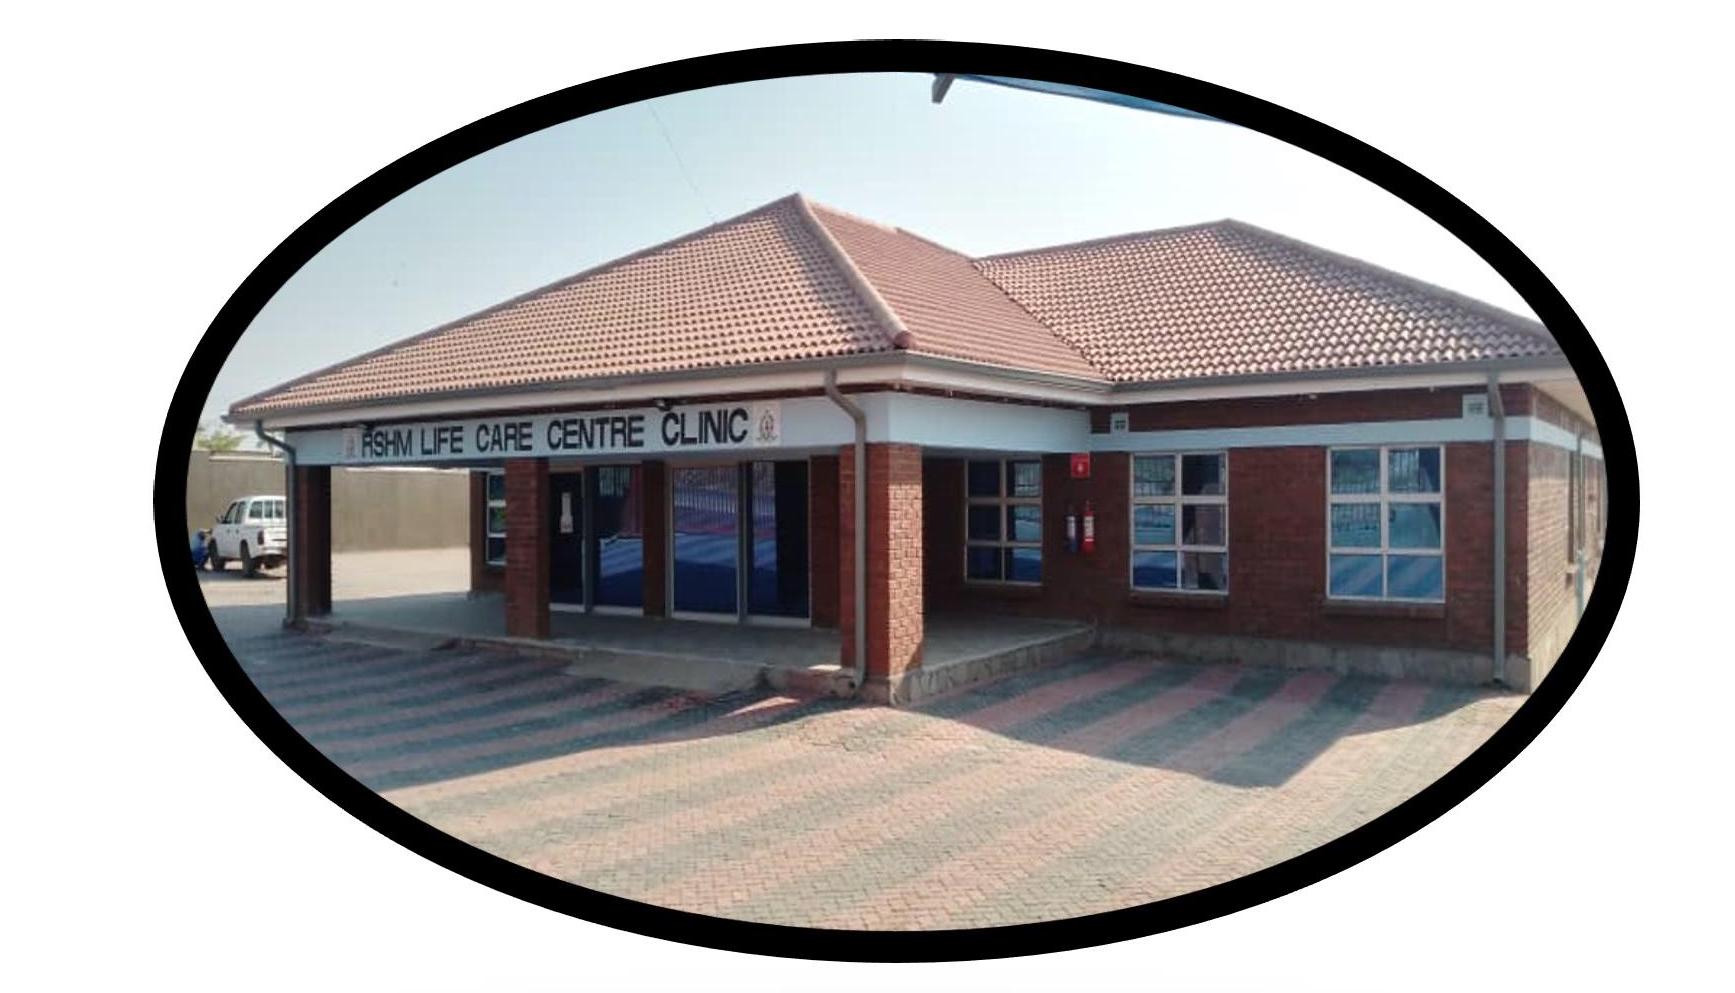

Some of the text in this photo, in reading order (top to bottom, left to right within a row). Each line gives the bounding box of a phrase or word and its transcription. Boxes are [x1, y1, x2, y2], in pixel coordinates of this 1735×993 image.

[361, 408, 749, 457] RSHM LIFE CARE CENTRE CLINIC
